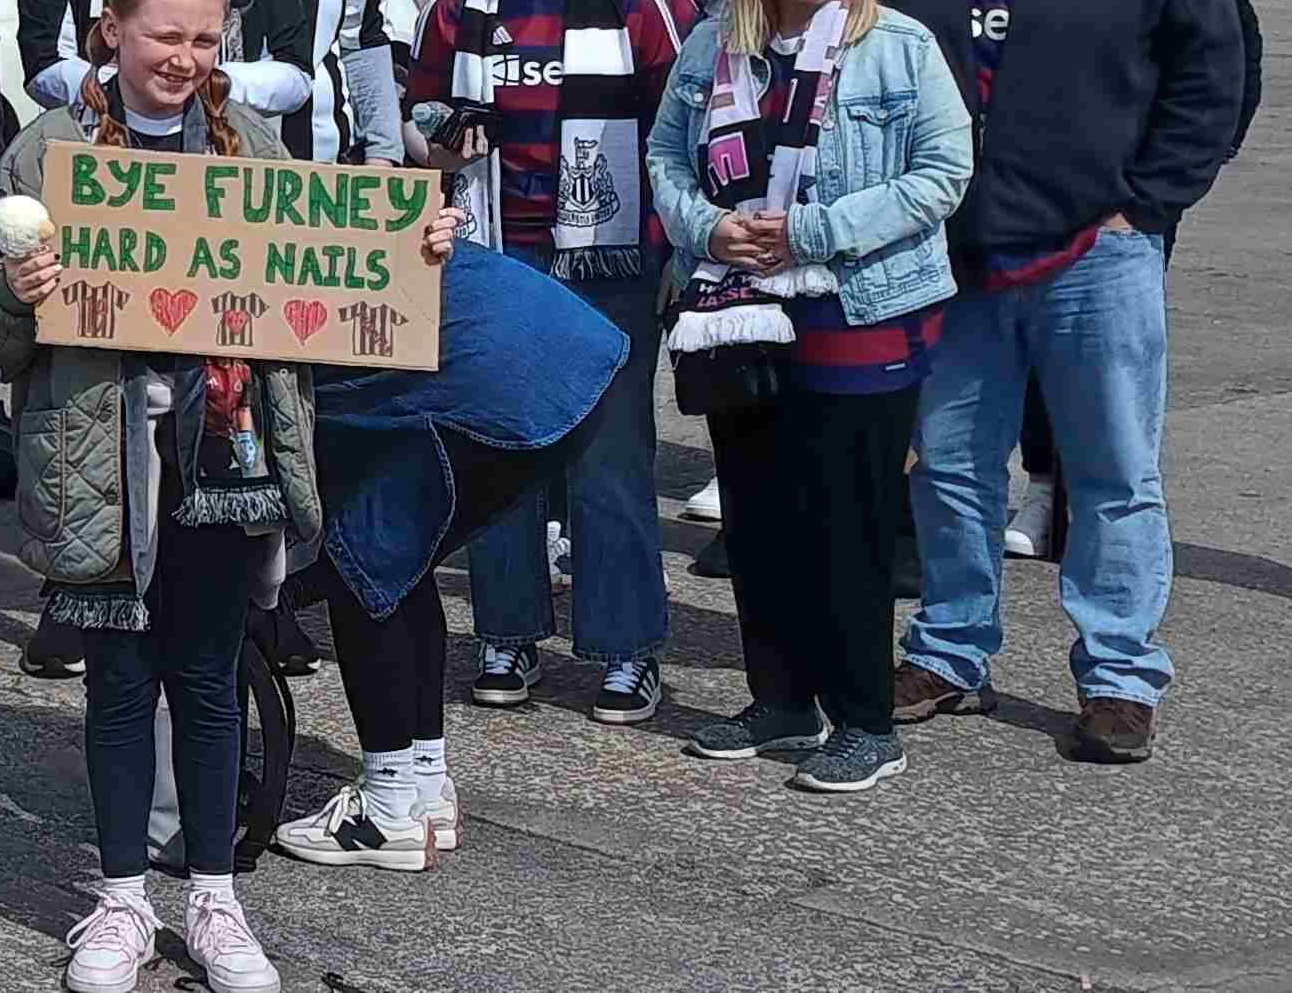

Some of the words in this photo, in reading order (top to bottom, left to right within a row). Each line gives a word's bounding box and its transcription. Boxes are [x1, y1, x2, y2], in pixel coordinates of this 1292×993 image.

[971, 7, 1010, 41] se
[522, 60, 564, 86] se
[70, 153, 178, 212] BYE
[204, 164, 430, 233] FURNEY
[61, 224, 168, 274] HARD
[186, 236, 243, 280] AS
[264, 241, 391, 293] NAILS
[696, 287, 754, 308] LASSE
